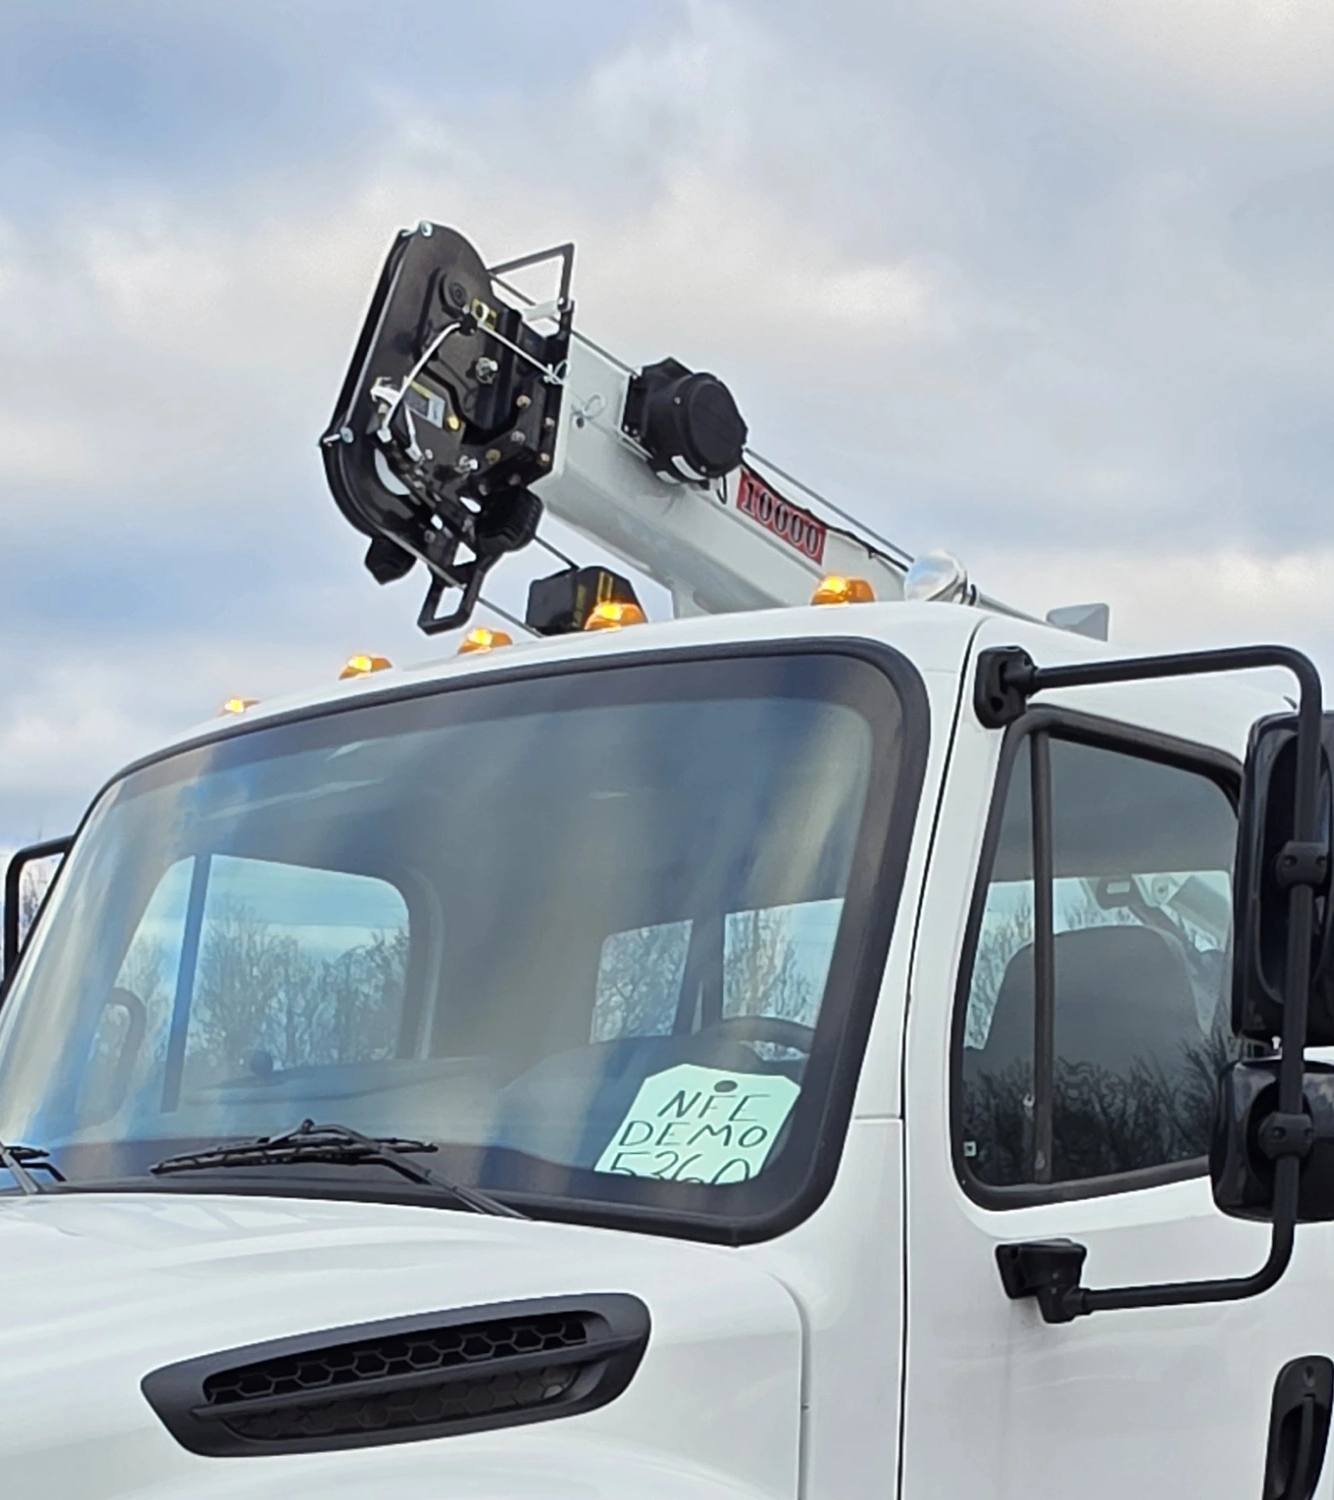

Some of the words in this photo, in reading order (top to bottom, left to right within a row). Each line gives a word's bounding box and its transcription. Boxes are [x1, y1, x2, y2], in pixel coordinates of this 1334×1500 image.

[743, 481, 820, 557] 10000
[657, 1090, 770, 1122] NFE
[619, 1120, 768, 1148] DEMO
